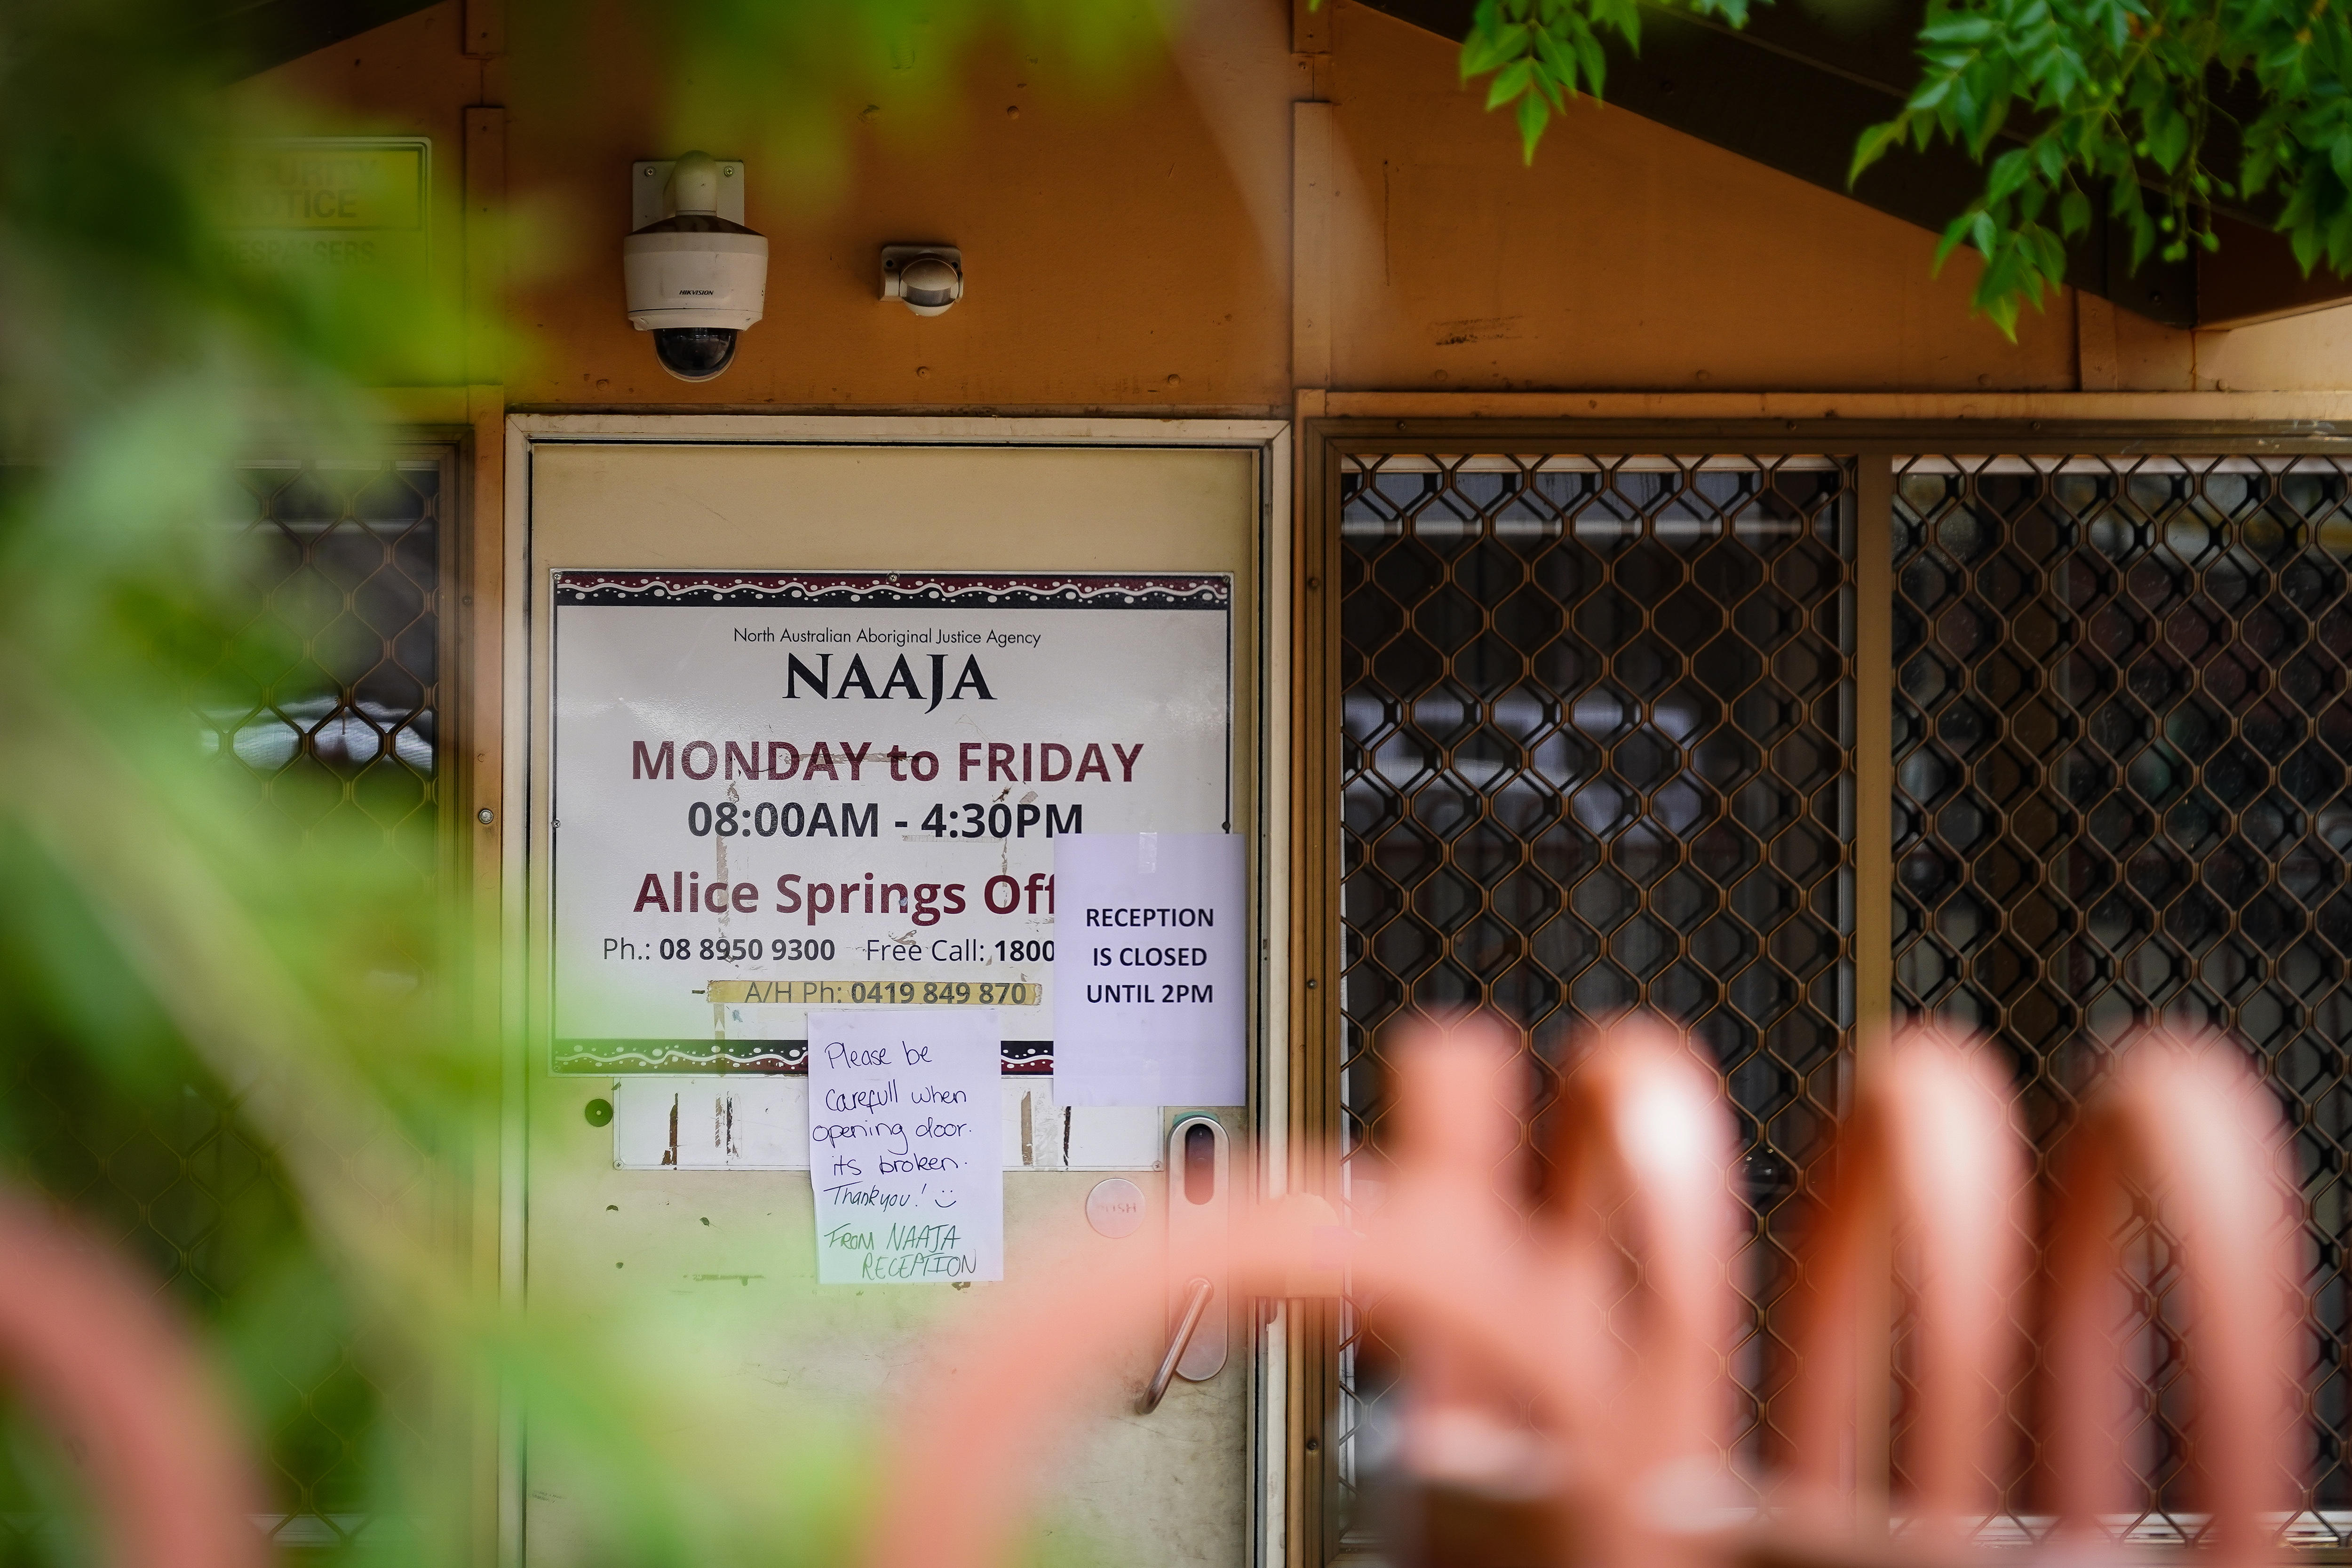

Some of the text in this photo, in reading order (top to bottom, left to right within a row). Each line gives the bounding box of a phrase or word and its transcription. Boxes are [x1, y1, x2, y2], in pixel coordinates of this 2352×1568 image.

[734, 627, 1041, 648] North Australian Aboriginal Justice Agency
[782, 652, 998, 714] NAAJA
[632, 740, 1144, 783] MONDAY to FRIDAY
[688, 801, 878, 839] 08:00AM
[922, 802, 1082, 839] 4:30PM
[633, 871, 759, 914] Alice
[776, 872, 966, 927] Springs
[1087, 908, 1214, 927] RECEPTION
[604, 938, 650, 961] Ph.:
[660, 939, 691, 961] 08
[699, 939, 763, 961] 8950
[772, 939, 835, 961] 9300
[866, 940, 922, 962] Free
[931, 940, 985, 962] Call:
[1094, 947, 1207, 966] IS CLOSED
[746, 982, 1026, 1005] A/H Ph: 0419 849 870
[1087, 984, 1213, 1003] UNTIL 2PM
[826, 1041, 932, 1069] Please be
[912, 1086, 966, 1104] when
[812, 1117, 972, 1155] opening door.
[833, 1154, 967, 1176] its broken.
[824, 1223, 961, 1252] FROM NAAJA
[862, 1249, 976, 1279] RECEPTION
